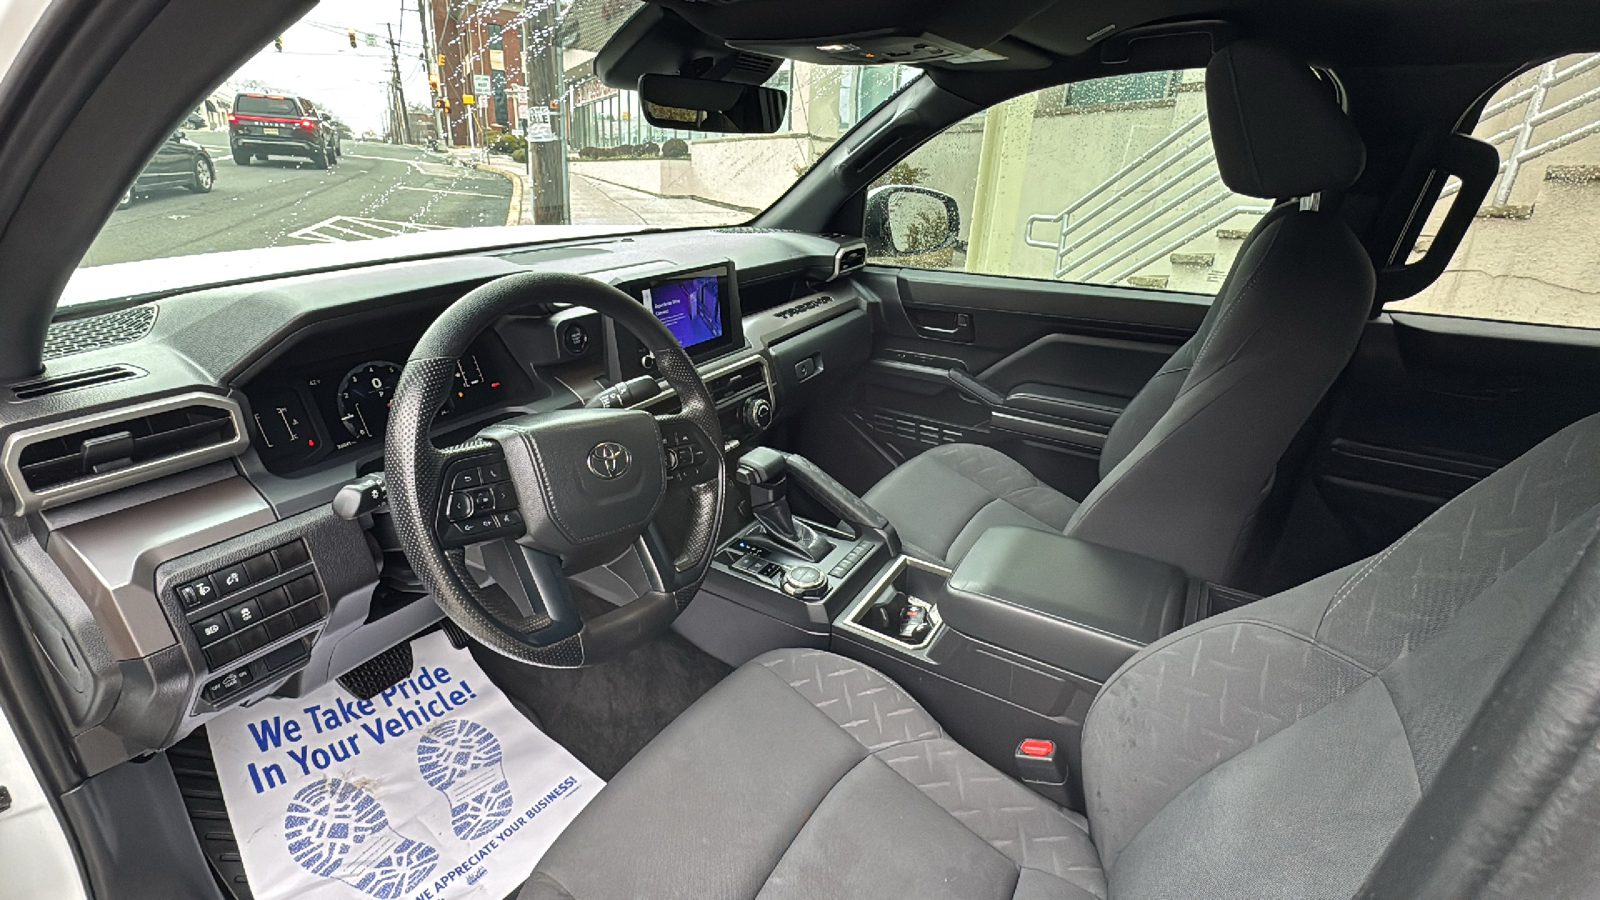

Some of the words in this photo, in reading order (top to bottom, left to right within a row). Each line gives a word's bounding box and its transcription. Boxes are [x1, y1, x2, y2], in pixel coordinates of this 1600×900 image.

[371, 377, 382, 389] 0
[211, 683, 221, 691] OFF
[247, 716, 303, 753] We
[304, 697, 376, 734] Take
[380, 667, 452, 707] Pride
[247, 762, 288, 794] In
[287, 733, 361, 776] Your
[361, 680, 478, 745] Vehicle!
[434, 840, 499, 894] APPRECIATE
[496, 817, 528, 842] YOUR
[525, 775, 578, 820] BUSINESS!
